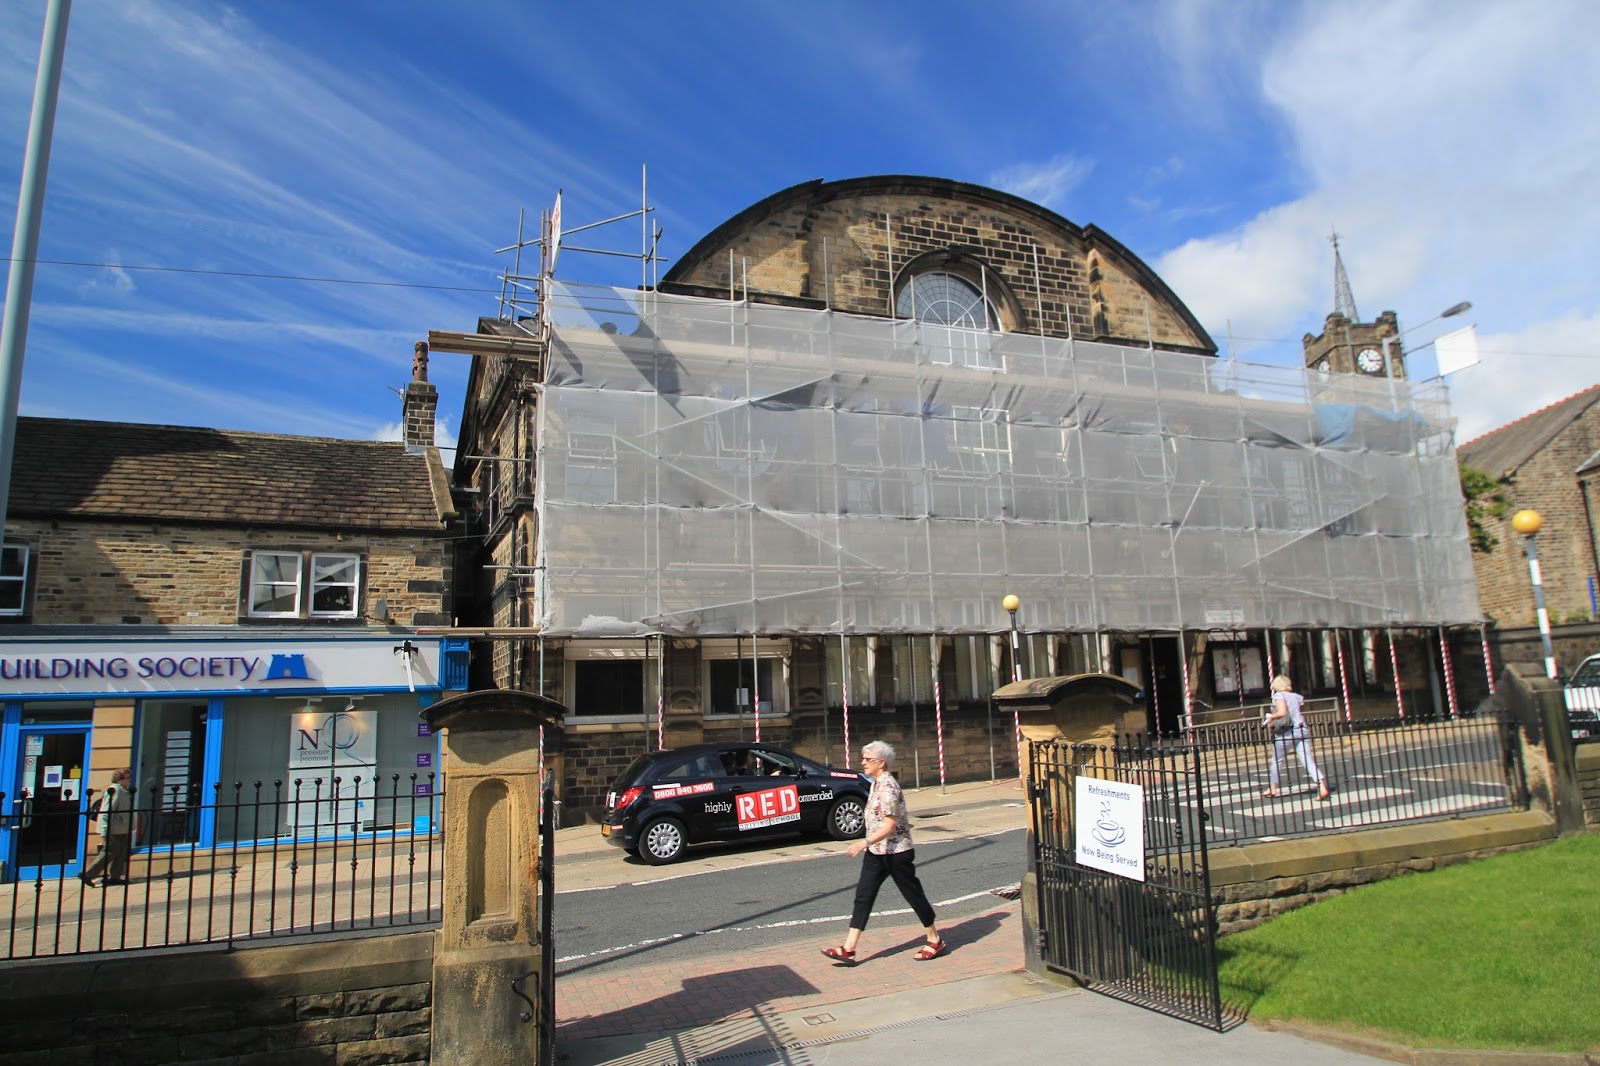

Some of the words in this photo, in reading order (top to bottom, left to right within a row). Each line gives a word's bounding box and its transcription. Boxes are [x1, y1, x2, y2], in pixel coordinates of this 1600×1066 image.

[300, 748, 331, 758] pressure
[300, 755, 329, 764] promise
[655, 790, 676, 799] 0800
[677, 786, 693, 795] 840
[693, 782, 714, 792] 3600
[1088, 785, 1130, 800] Refreshments
[704, 801, 733, 814] highly
[738, 788, 797, 820] RED
[739, 819, 770, 831] DRIVING
[770, 813, 800, 826] SCHOOL
[1082, 846, 1095, 856] Now
[1097, 849, 1114, 863] Being
[1116, 853, 1138, 867] Served
